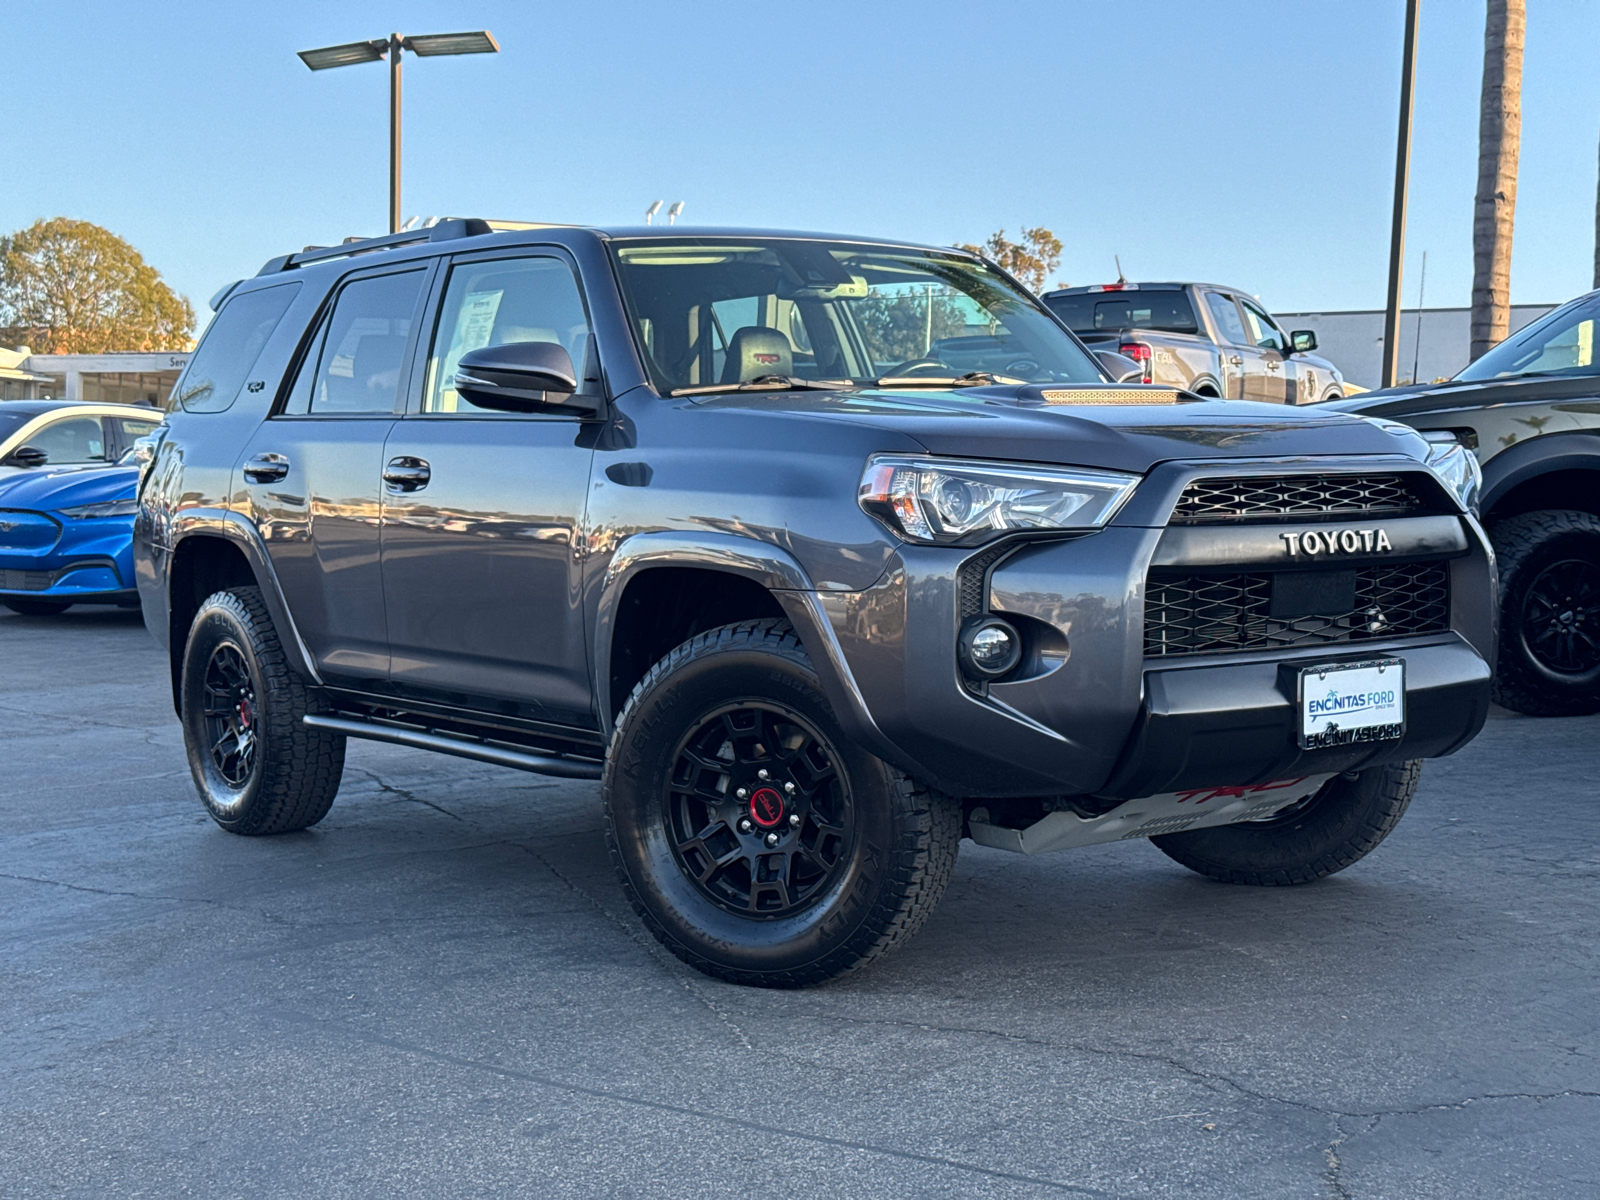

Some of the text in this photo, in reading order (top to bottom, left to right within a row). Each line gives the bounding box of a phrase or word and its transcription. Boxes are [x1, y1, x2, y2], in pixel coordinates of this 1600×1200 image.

[753, 353, 779, 364] TRD
[1281, 529, 1392, 556] TOYOTA
[1309, 690, 1395, 713] ENCINITAS FORD
[622, 679, 682, 785] KELLY
[1372, 724, 1402, 740] FORD
[757, 793, 776, 820] TRD
[819, 840, 882, 941] KELLY
